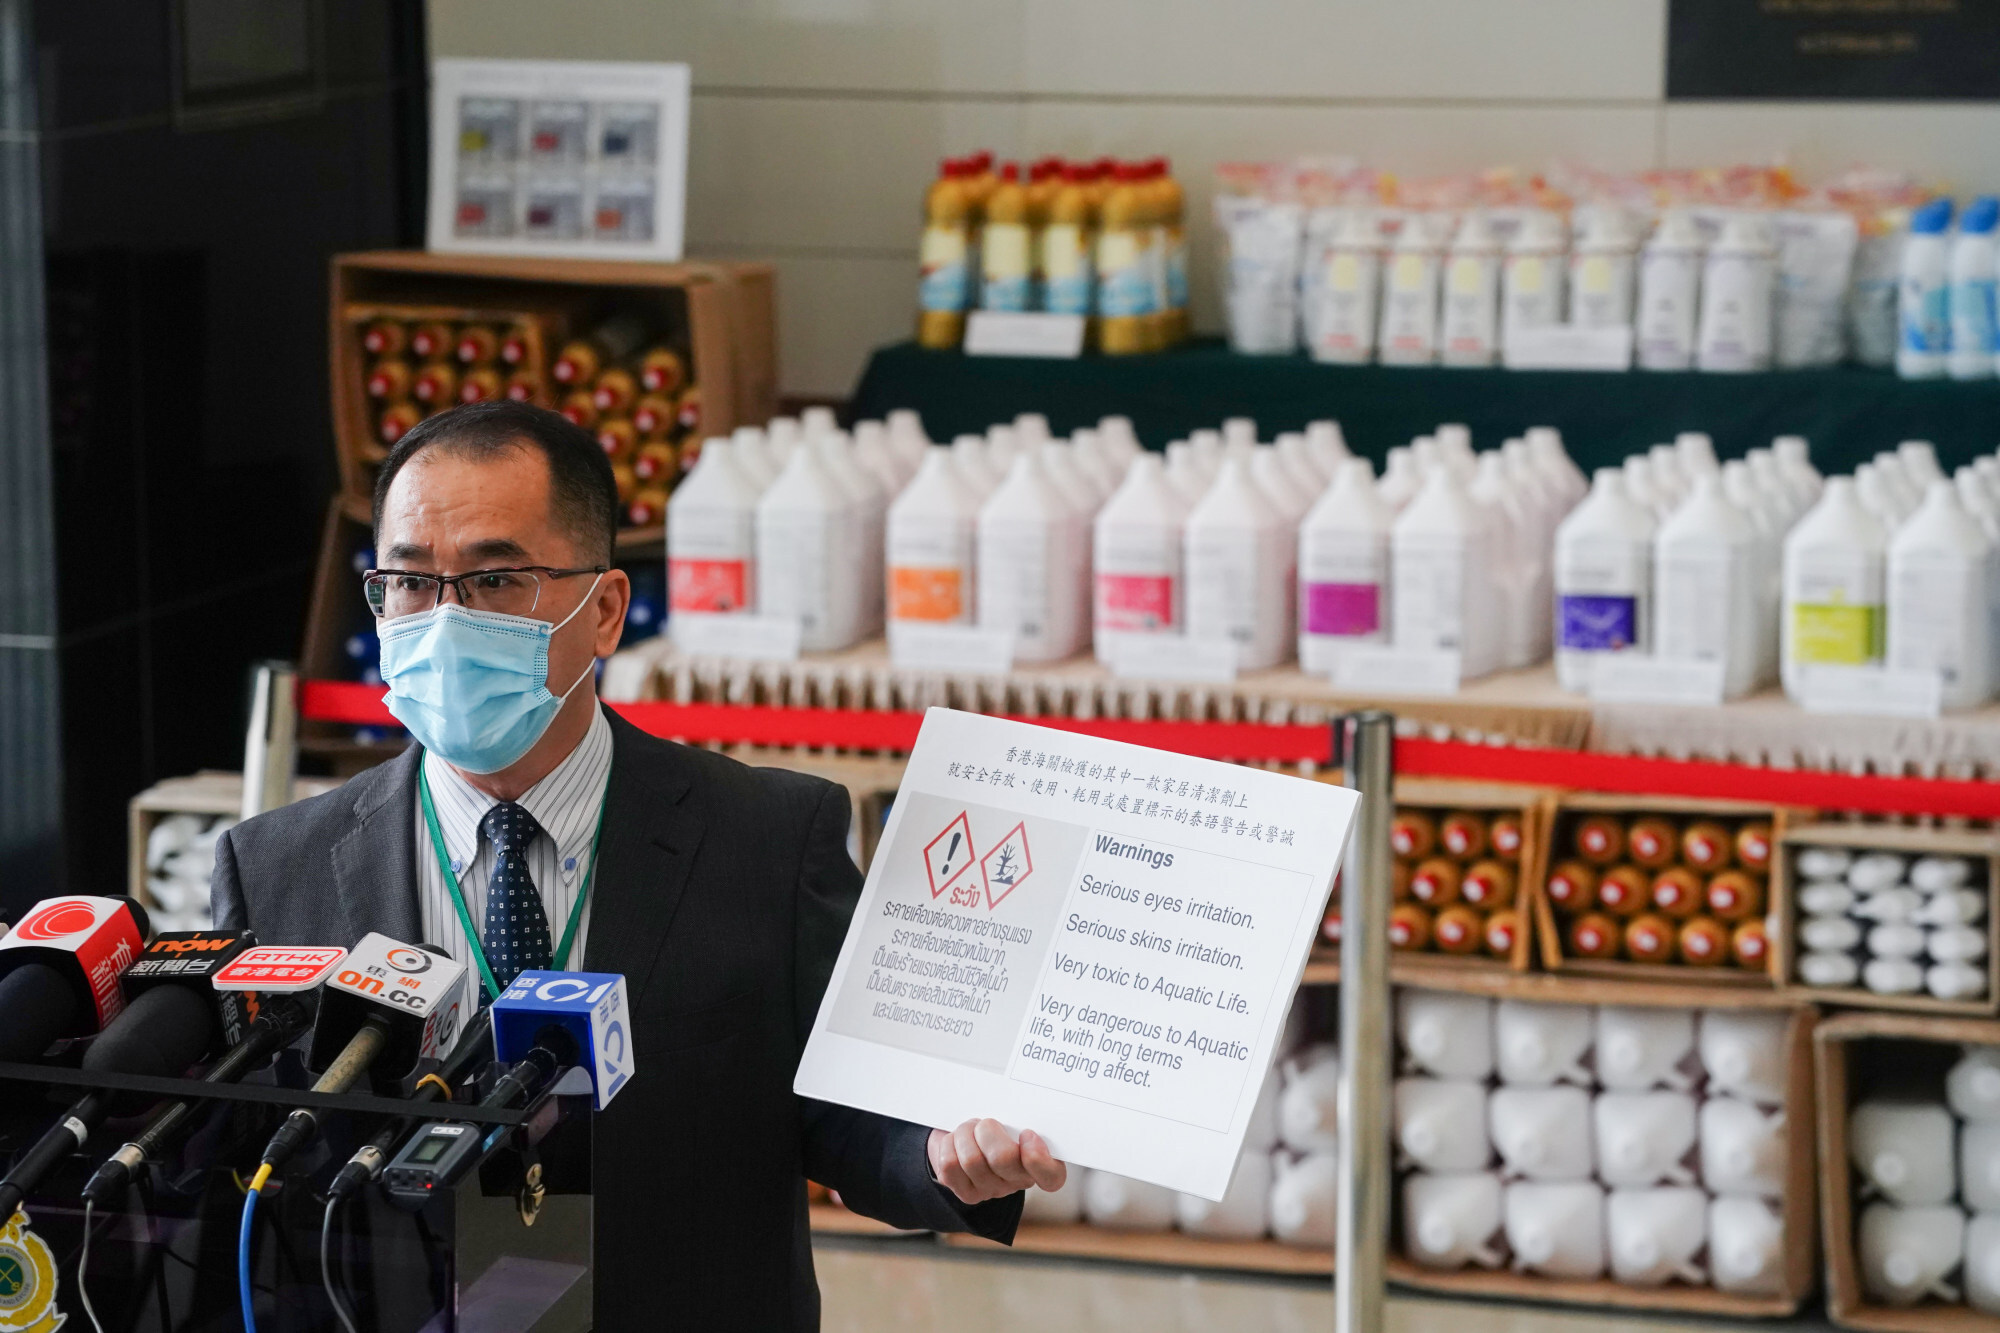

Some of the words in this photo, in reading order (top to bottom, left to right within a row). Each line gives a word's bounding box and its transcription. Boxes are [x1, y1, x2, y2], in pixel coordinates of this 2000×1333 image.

[1006, 746, 1248, 808] 香港海關檢獲的其中一款家居清潔劑上
[1095, 834, 1175, 869] Warnings
[950, 883, 980, 908] ระวัง
[1080, 874, 1140, 903] Serious
[1144, 892, 1183, 912] eyes
[1186, 897, 1255, 929] irritation.
[149, 935, 236, 956] now
[247, 953, 332, 962] RTHK
[1066, 913, 1126, 942] Serious
[1130, 929, 1172, 953] skins
[1175, 938, 1244, 970] irritation.
[128, 959, 216, 974] 新聞台
[229, 967, 314, 977] 香港電台
[1055, 952, 1089, 980] Very
[1092, 962, 1130, 986] toxic
[1134, 972, 1149, 990] to
[1151, 976, 1213, 1006] Aquatic
[1216, 990, 1250, 1015] Life.
[337, 970, 427, 1009] on.cc
[1030, 1016, 1055, 1042] life,
[1062, 1027, 1094, 1049] with
[1098, 1033, 1132, 1061] long
[1136, 1045, 1183, 1070] terms
[1040, 993, 1075, 1022] Very
[1077, 1004, 1162, 1040] dangerous
[1166, 1025, 1182, 1044] to
[1184, 1030, 1249, 1061] Aquatic
[1022, 1041, 1100, 1079] damaging
[1103, 1061, 1151, 1088] affect.
